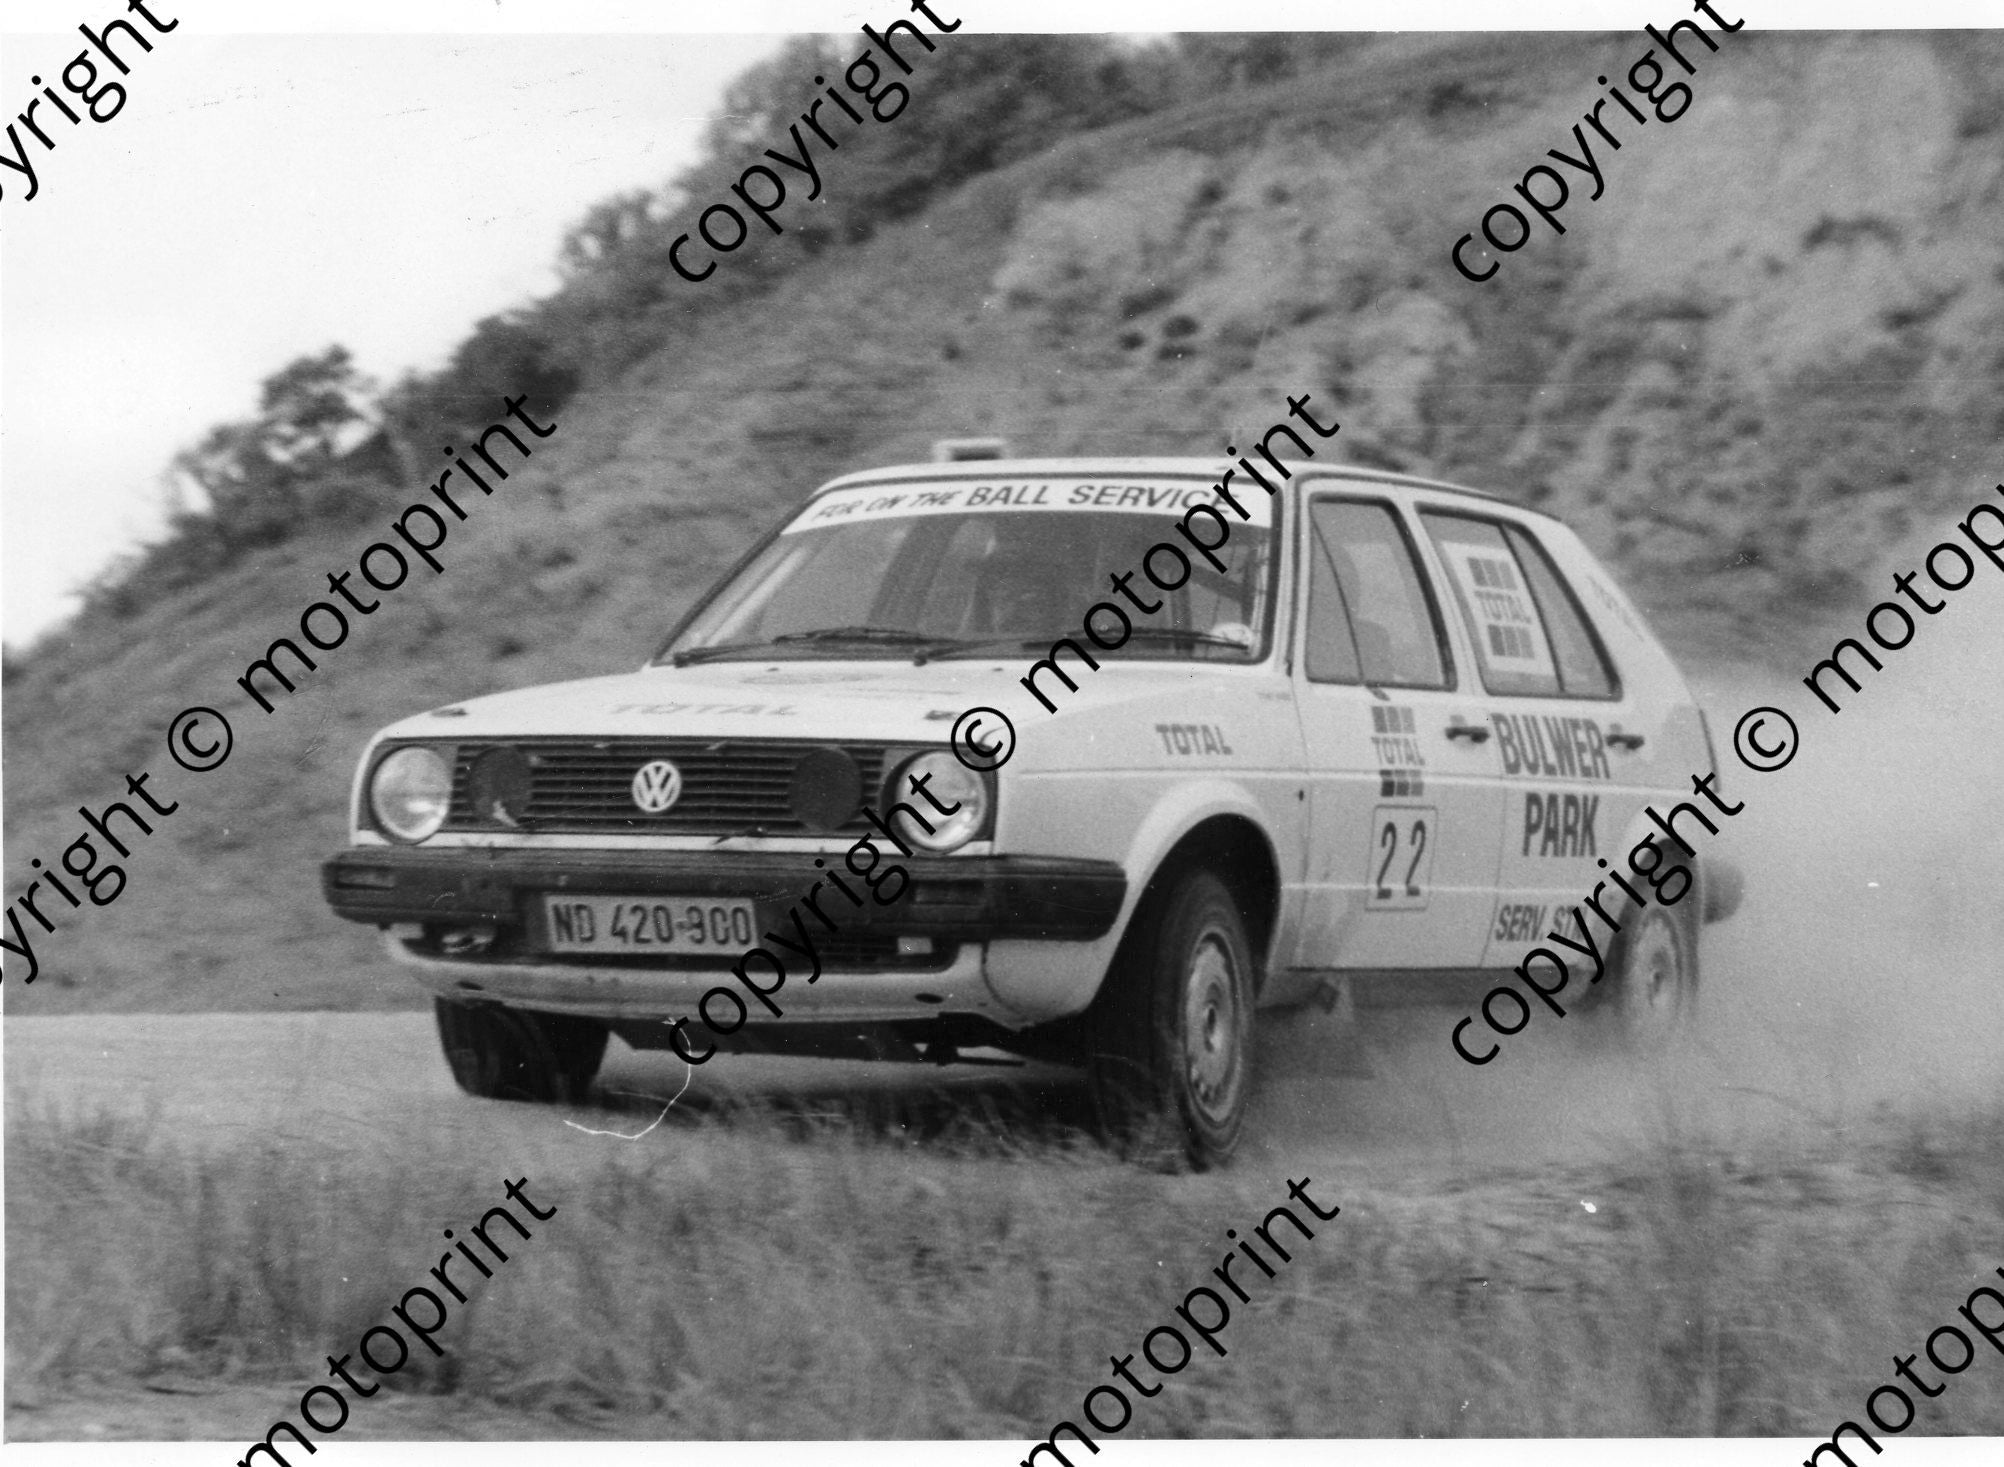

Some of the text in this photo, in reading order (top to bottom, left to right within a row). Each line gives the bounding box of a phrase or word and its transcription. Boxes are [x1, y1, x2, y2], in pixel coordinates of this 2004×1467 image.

[813, 484, 1240, 522] FOR ON THE BALL SERVICE
[1474, 590, 1532, 624] TOTAL
[611, 702, 799, 716] TOTAL
[1155, 724, 1233, 755] TOTAL
[1371, 736, 1426, 766] TOTAL
[1490, 712, 1611, 780] BULWER
[1522, 792, 1600, 857] PARK
[1376, 818, 1427, 900] 22
[551, 903, 597, 943] ND
